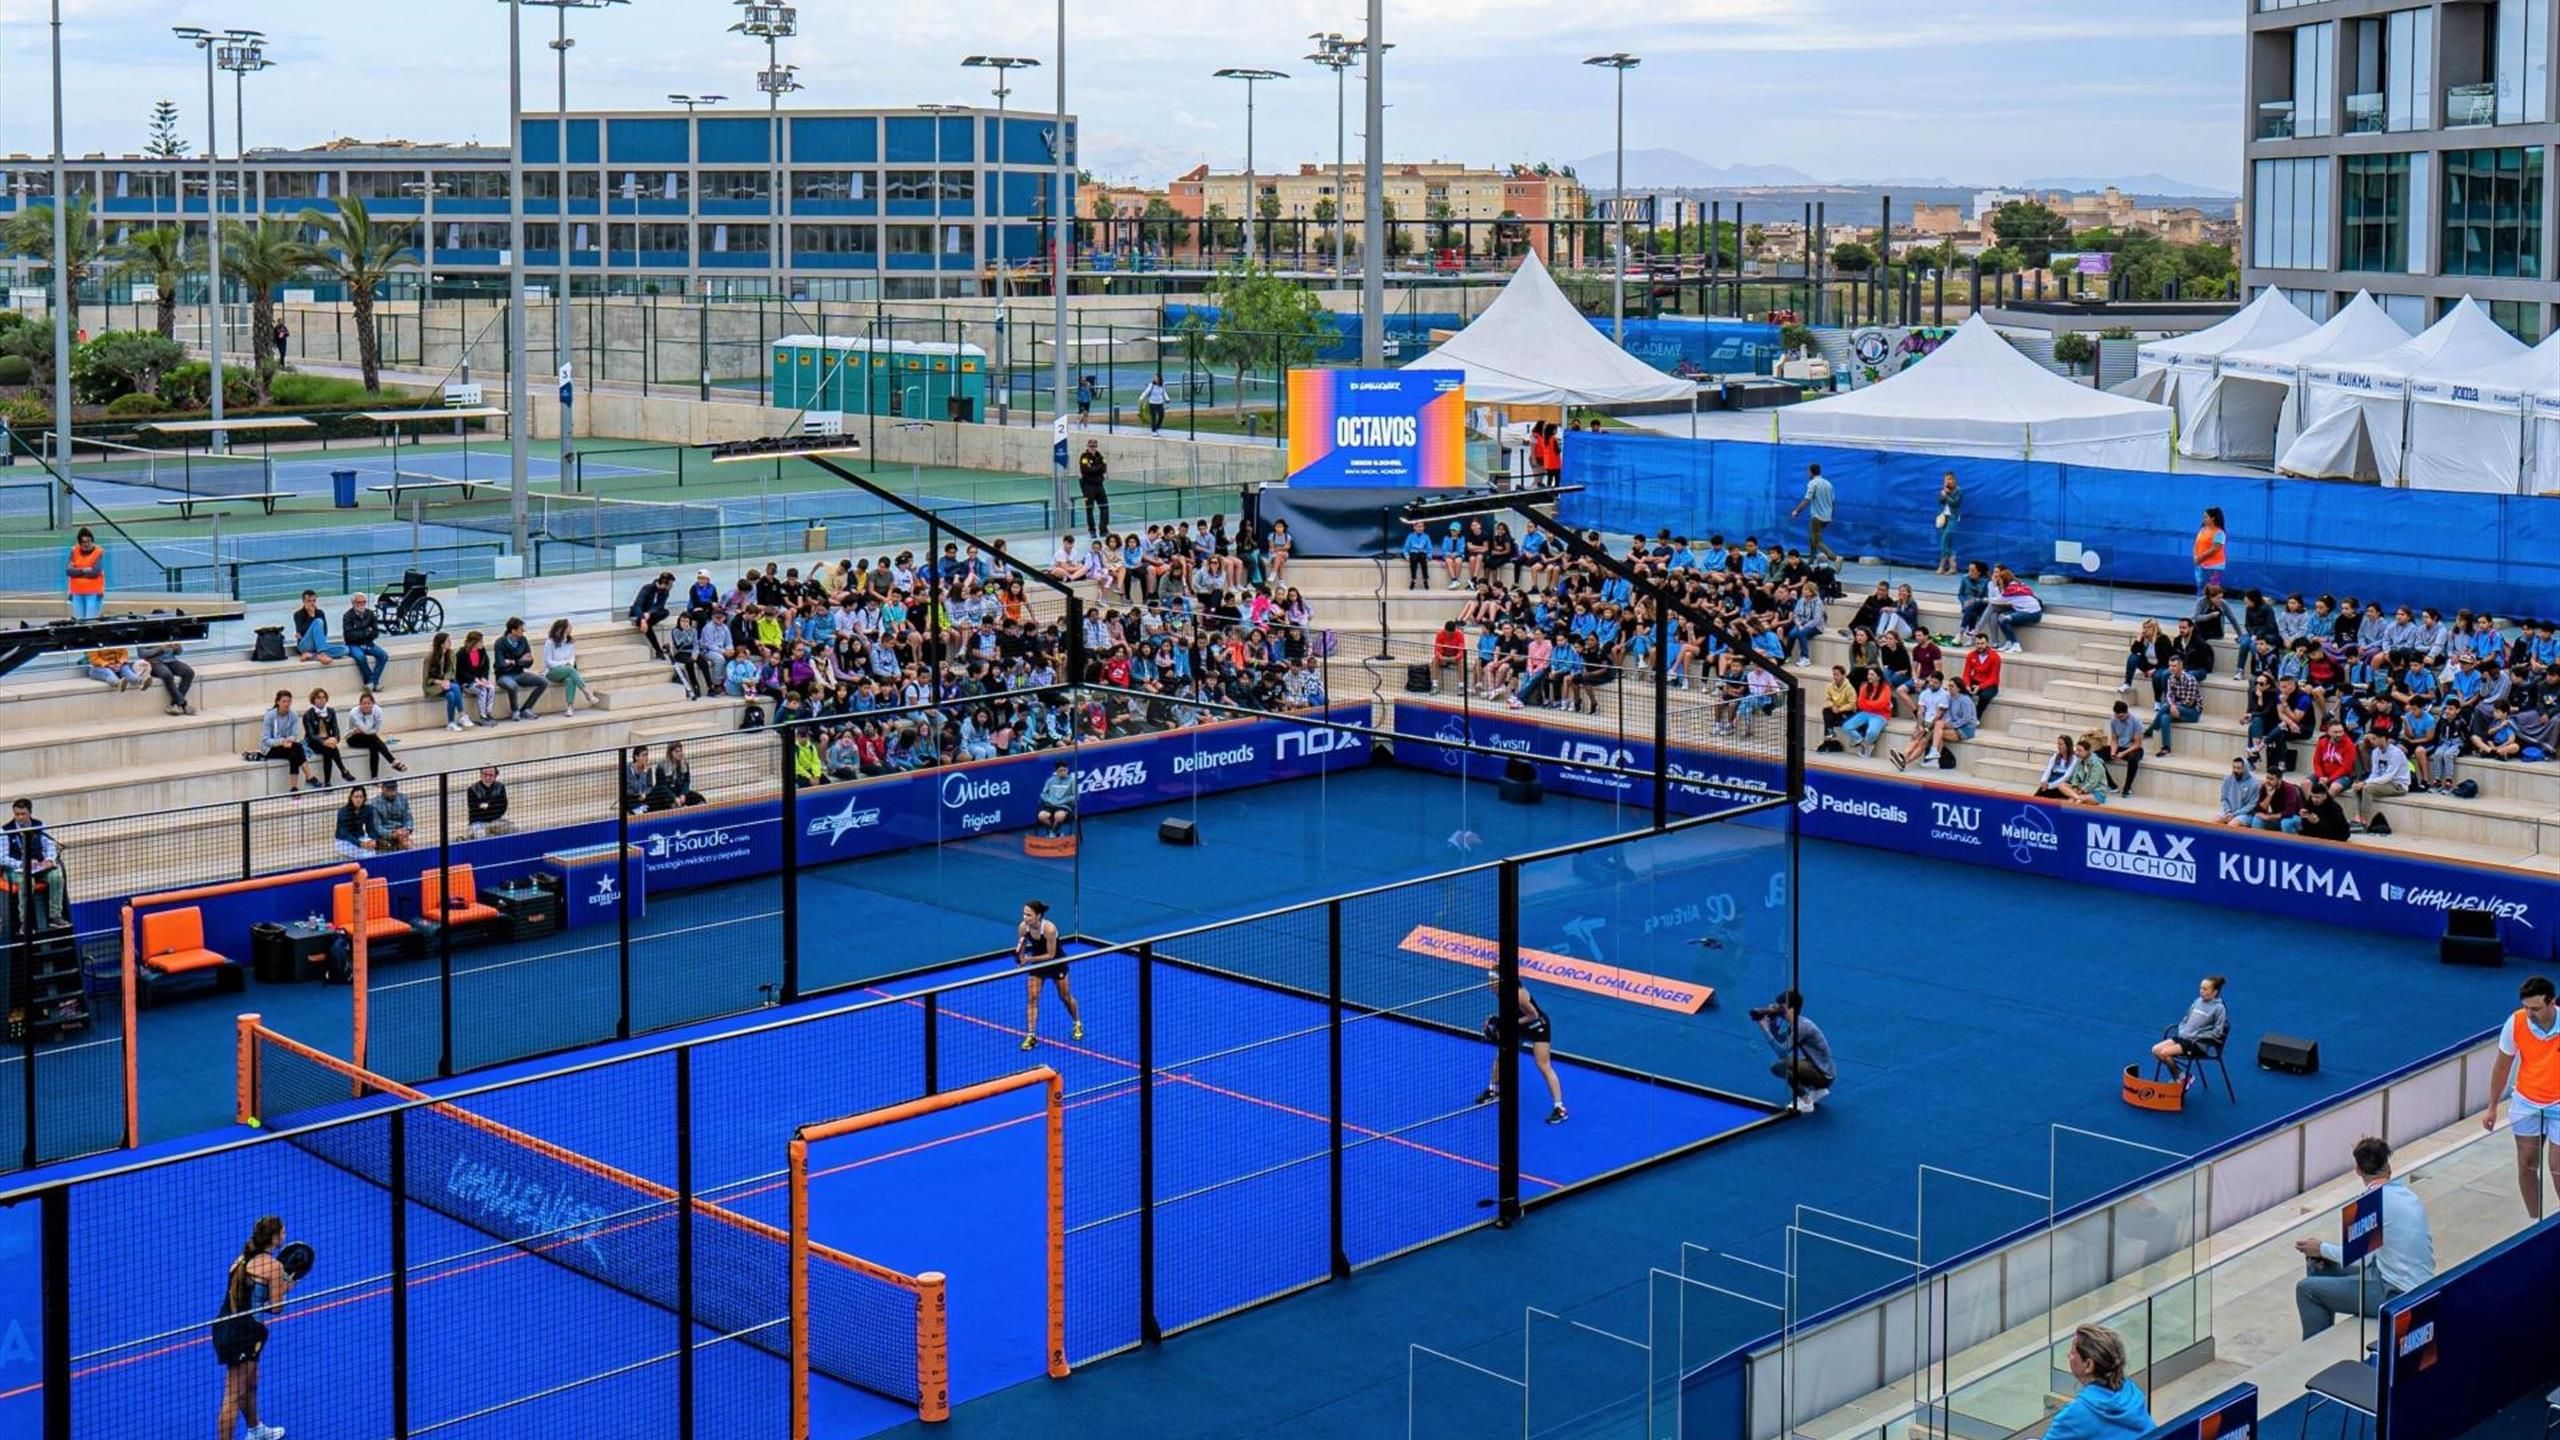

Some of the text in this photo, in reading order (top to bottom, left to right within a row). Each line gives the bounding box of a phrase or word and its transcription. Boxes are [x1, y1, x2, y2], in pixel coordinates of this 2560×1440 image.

[2337, 371, 2371, 390] KUIKMA
[1058, 424, 1065, 434] 2
[1337, 416, 1417, 447] OCTAVOS
[1173, 743, 1254, 774] Delibreads
[953, 779, 1011, 804] Midea
[1076, 770, 1147, 794] UESTRO
[1931, 801, 1982, 831] TAU
[2001, 823, 2058, 845] Mallorca
[2087, 822, 2196, 863] MAX
[2088, 849, 2195, 881] COLCHON
[2219, 850, 2362, 902] KUIKMA
[2407, 886, 2535, 929] CHALLENGER
[1519, 957, 1593, 984] MALLORCA
[1594, 974, 1694, 1005] CHALLENGER
